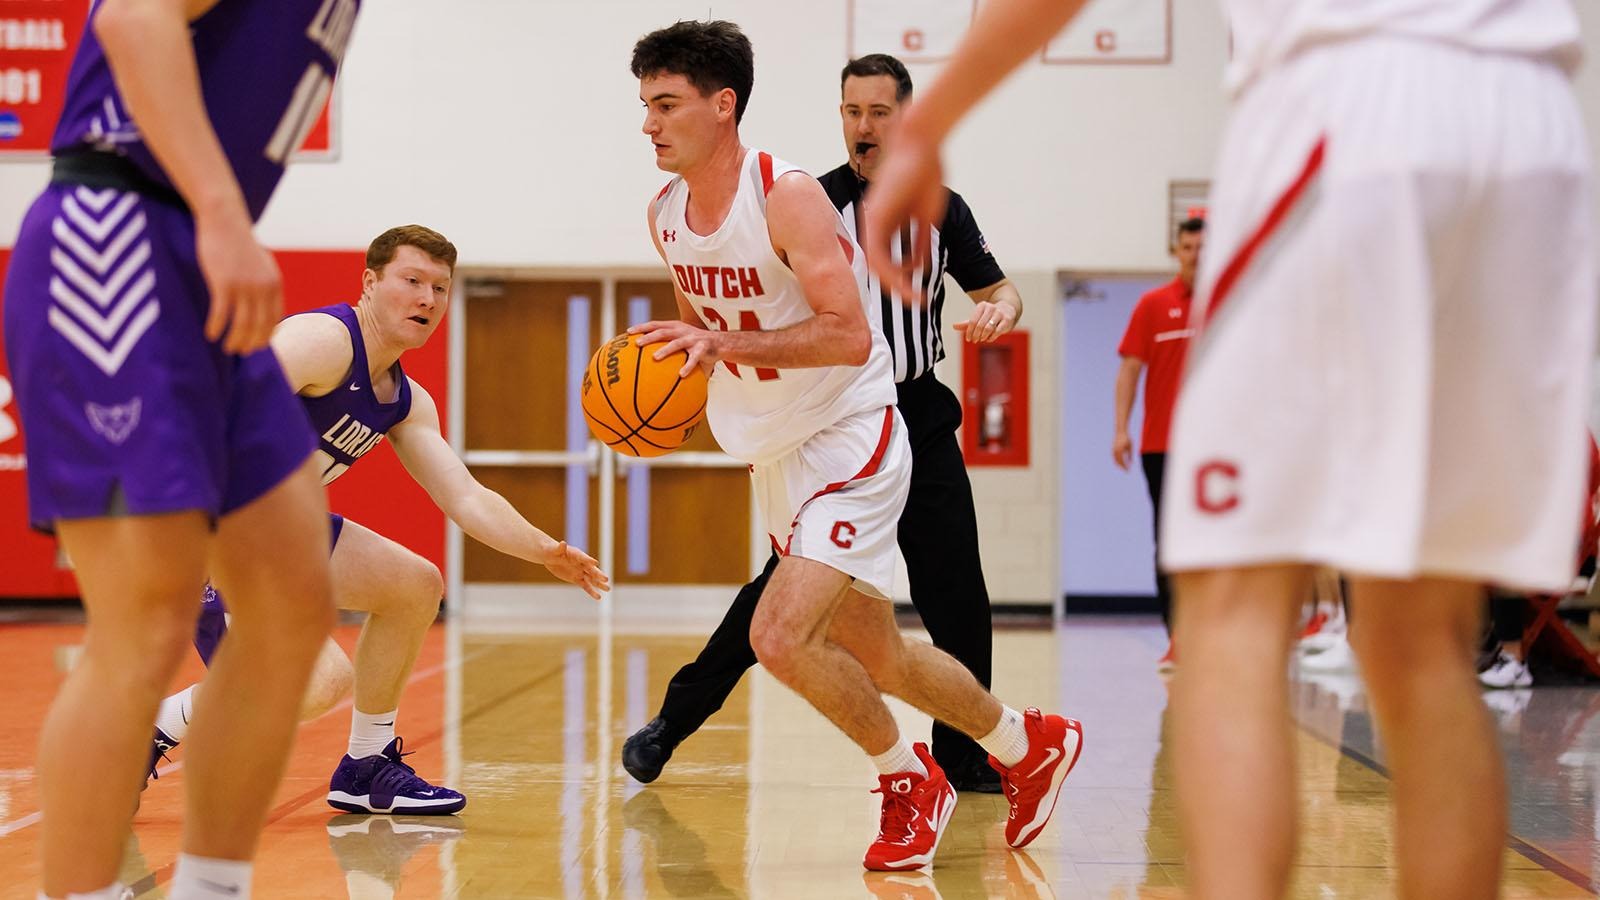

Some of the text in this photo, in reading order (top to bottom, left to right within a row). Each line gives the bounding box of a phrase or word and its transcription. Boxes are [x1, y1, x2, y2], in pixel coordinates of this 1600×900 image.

[672, 264, 765, 298] DUTCH
[1194, 461, 1239, 515] C
[830, 521, 857, 549] C
